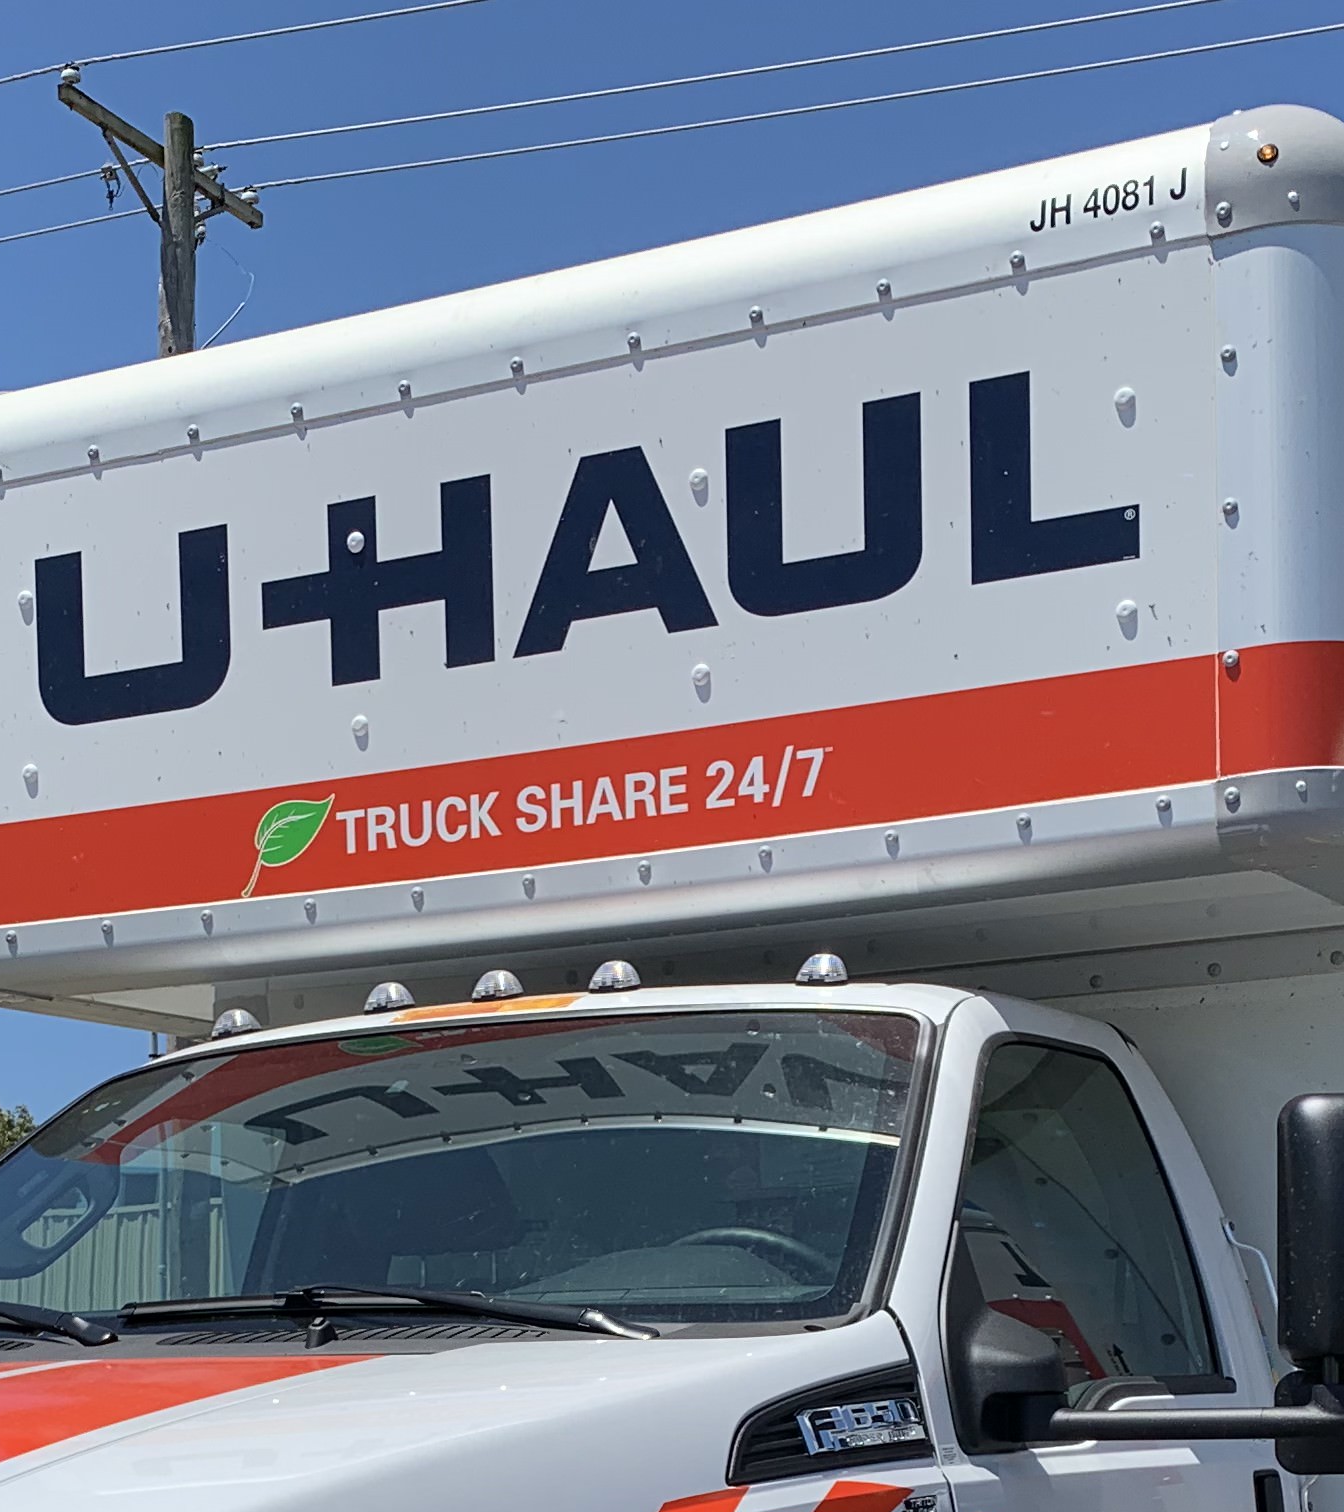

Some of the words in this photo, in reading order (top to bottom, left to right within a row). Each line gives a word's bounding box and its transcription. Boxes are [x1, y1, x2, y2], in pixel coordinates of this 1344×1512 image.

[1029, 193, 1072, 232] JH
[1083, 175, 1155, 219] 4081
[1169, 167, 1188, 200] J
[34, 370, 1141, 727] U-HAUL
[335, 791, 503, 855] TRUCK
[515, 765, 689, 834] SHARE
[704, 744, 826, 810] 24/7
